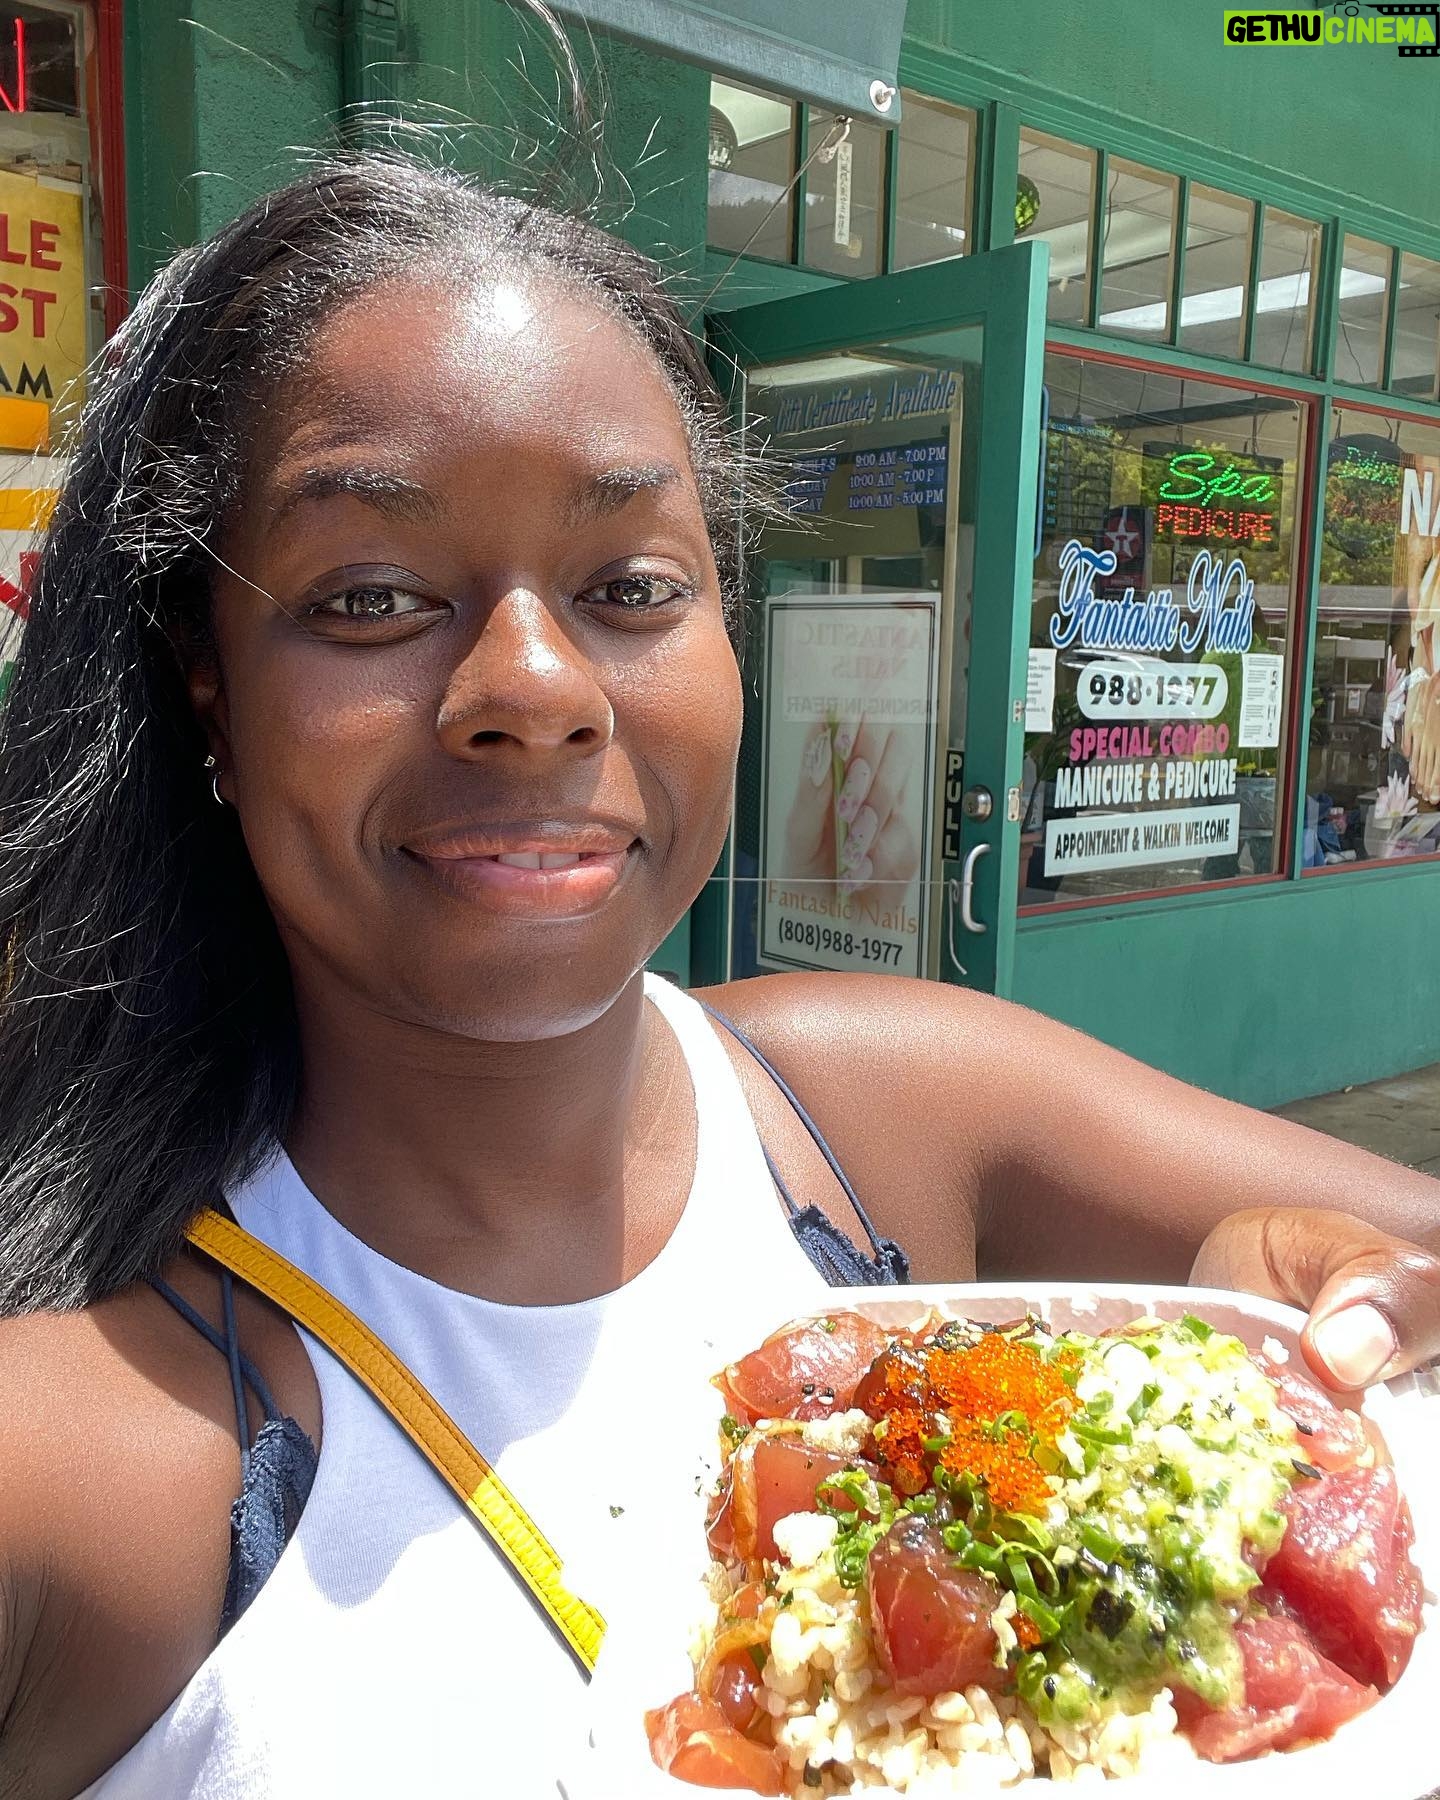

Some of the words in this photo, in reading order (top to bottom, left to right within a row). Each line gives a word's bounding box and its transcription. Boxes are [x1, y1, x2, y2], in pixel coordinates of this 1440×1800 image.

[881, 368, 957, 422] Available
[877, 472, 895, 487] AM
[878, 451, 897, 467] AM
[928, 446, 946, 462] PM
[1160, 453, 1275, 506] Spa
[875, 493, 893, 508] AM
[925, 488, 944, 504] PM
[1158, 504, 1272, 541] PEDICURE
[1050, 539, 1180, 651] Fantastic
[1179, 549, 1256, 653] Nails
[1069, 725, 1153, 762] SPECIAL
[1160, 723, 1230, 757] COMBO
[945, 753, 963, 857] PULL
[1054, 763, 1144, 809] MANICURE
[1148, 762, 1160, 801] &
[1165, 758, 1238, 800] PEDICURE
[1054, 827, 1129, 860] APPOINTMENT
[1132, 826, 1140, 852] &
[1143, 823, 1180, 850] WALKIN
[1185, 818, 1230, 846] WELCOME
[767, 880, 852, 920] Fantastic
[859, 898, 918, 935] Nails
[779, 917, 903, 966] (808)988-1977
